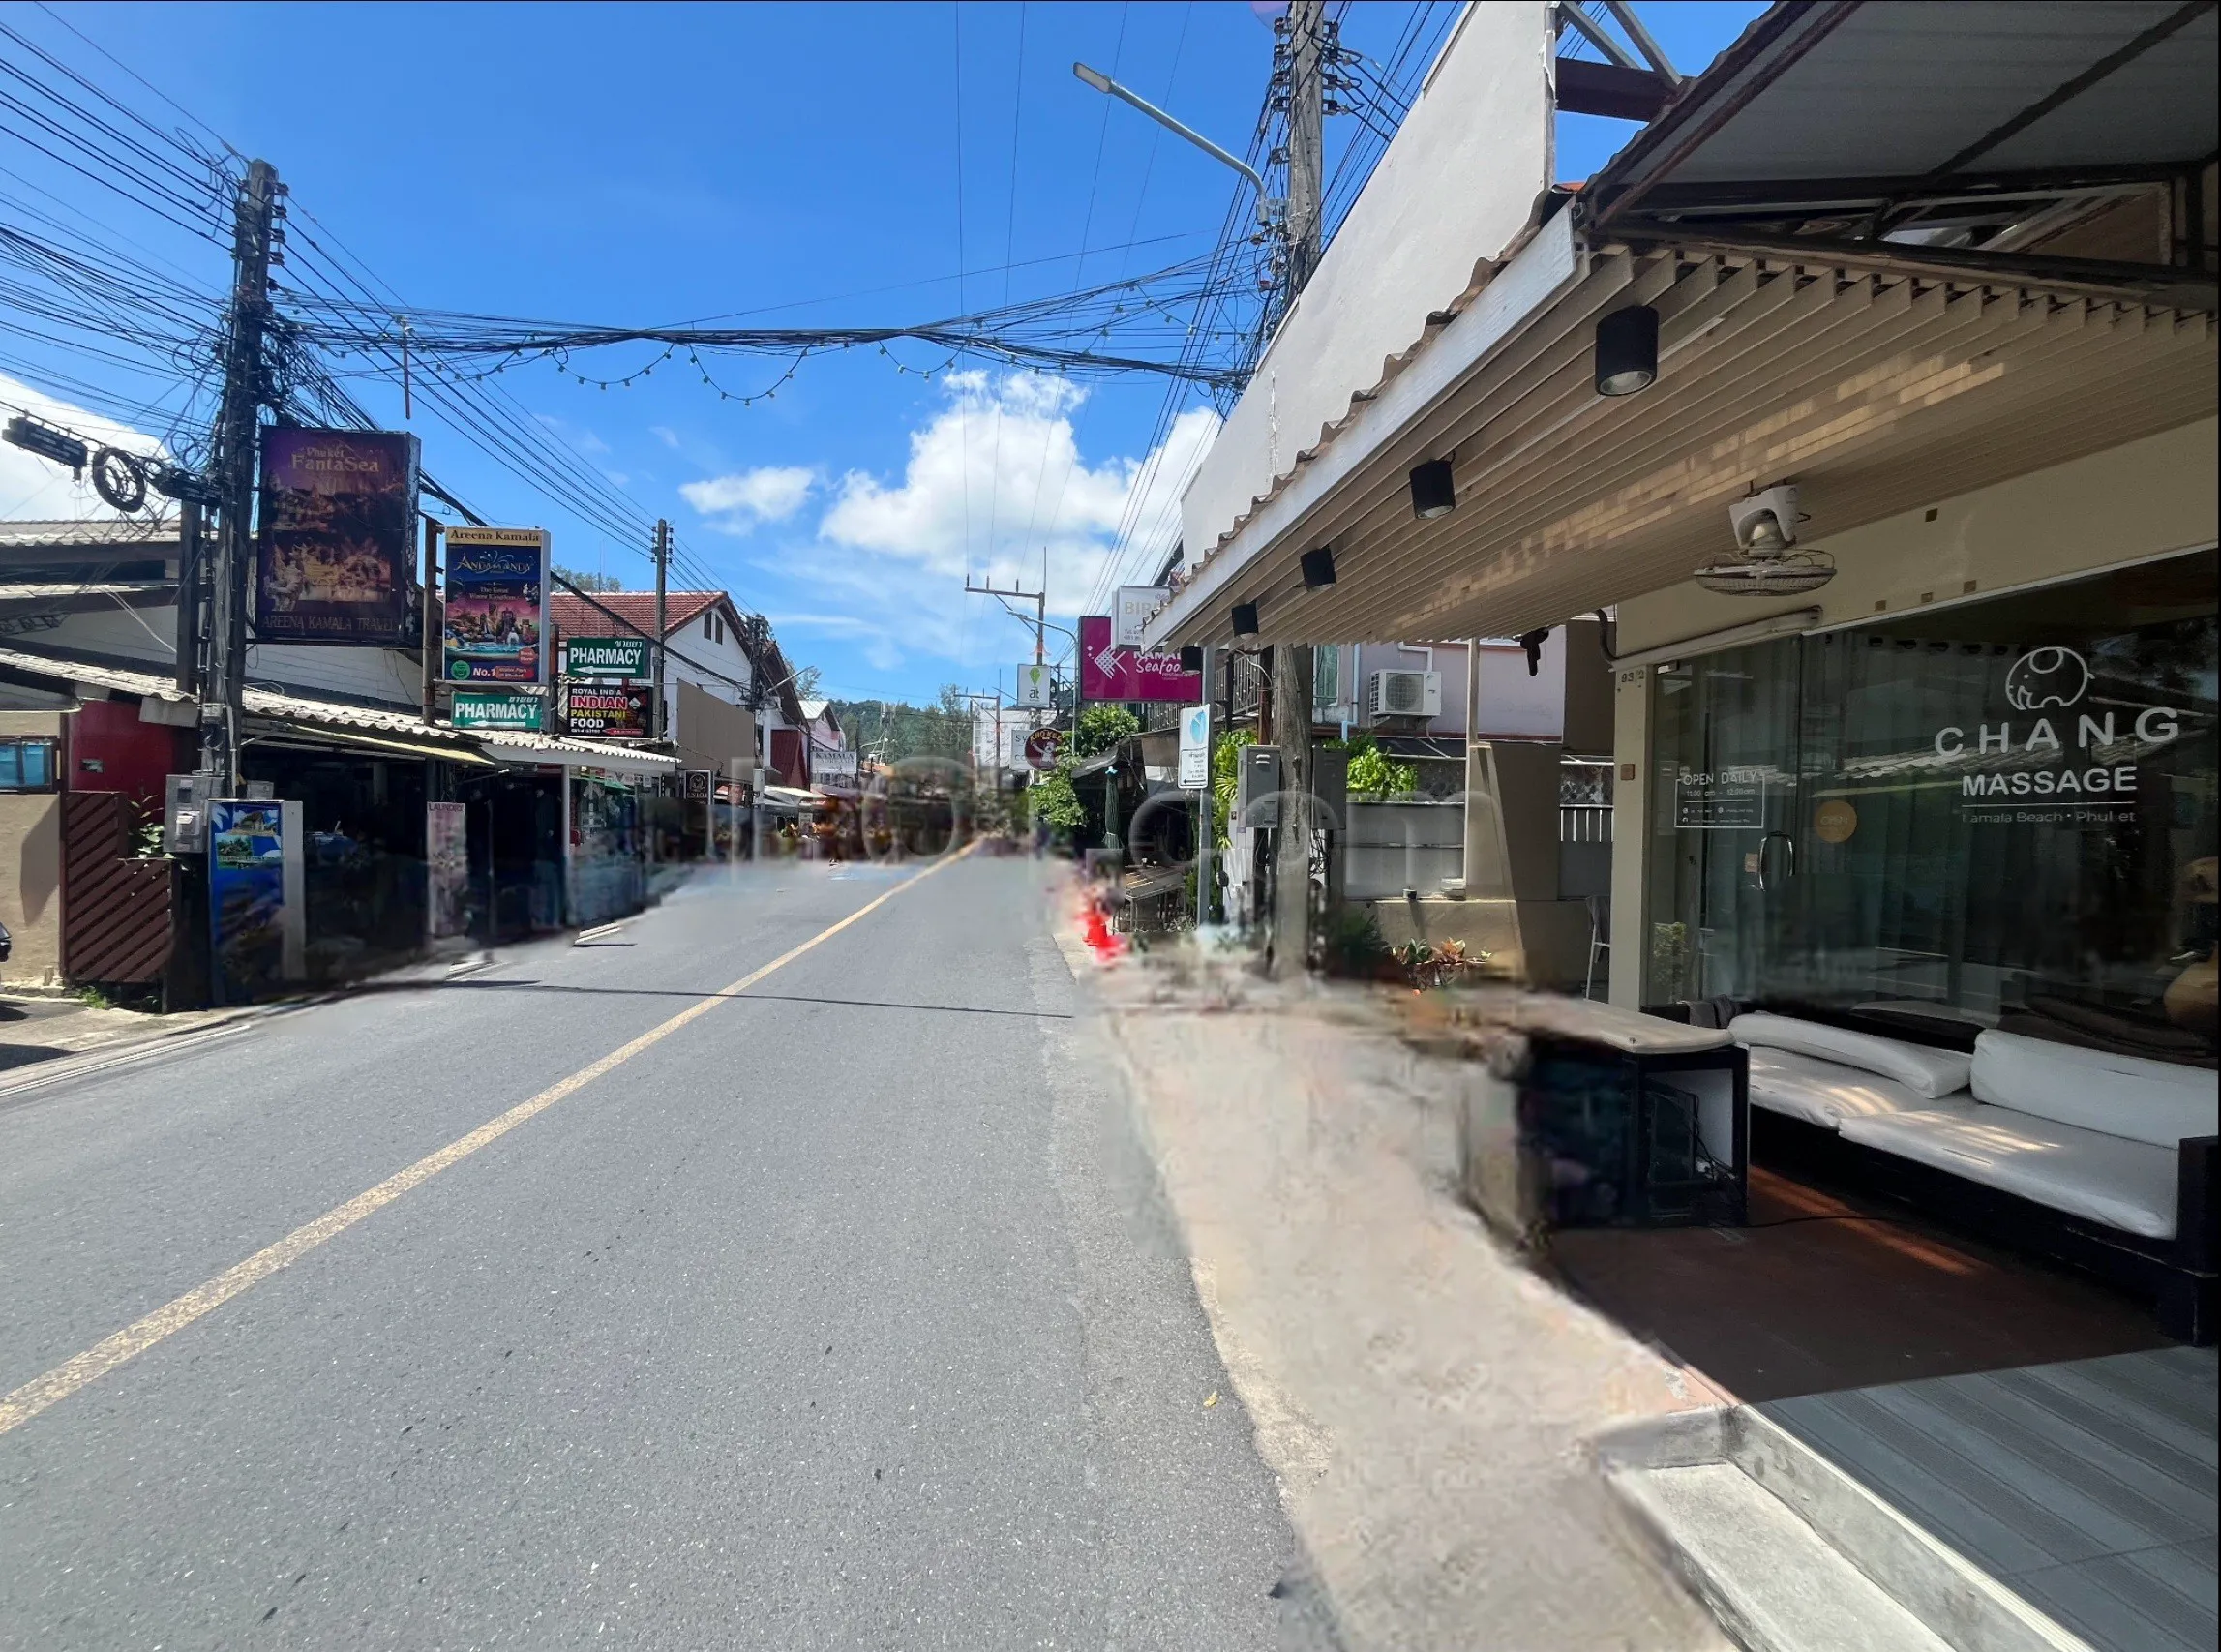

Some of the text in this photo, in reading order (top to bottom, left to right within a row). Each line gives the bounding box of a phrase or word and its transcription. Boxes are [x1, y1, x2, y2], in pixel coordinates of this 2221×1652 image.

[306, 447, 345, 458] Phuket
[291, 453, 380, 473] FantaSea
[450, 530, 540, 543] Areena Kamala
[1125, 601, 1159, 616] BIR
[262, 616, 304, 629] AREENA
[309, 616, 352, 631] KAMALA
[569, 647, 642, 665] PHARMACY
[473, 668, 495, 676] No.1
[1136, 658, 1182, 674] Seafoo
[570, 696, 628, 709] INDIAN
[455, 703, 537, 719] PHARMACY
[571, 709, 626, 719] PAKISTANI
[570, 718, 604, 728] FOOD
[1935, 706, 2179, 756] CHANG
[1683, 771, 1757, 786] OPEN DAILY
[1962, 766, 2139, 796] MASSAGE
[429, 803, 464, 812] LAUNDRY
[2016, 810, 2063, 823] Beach
